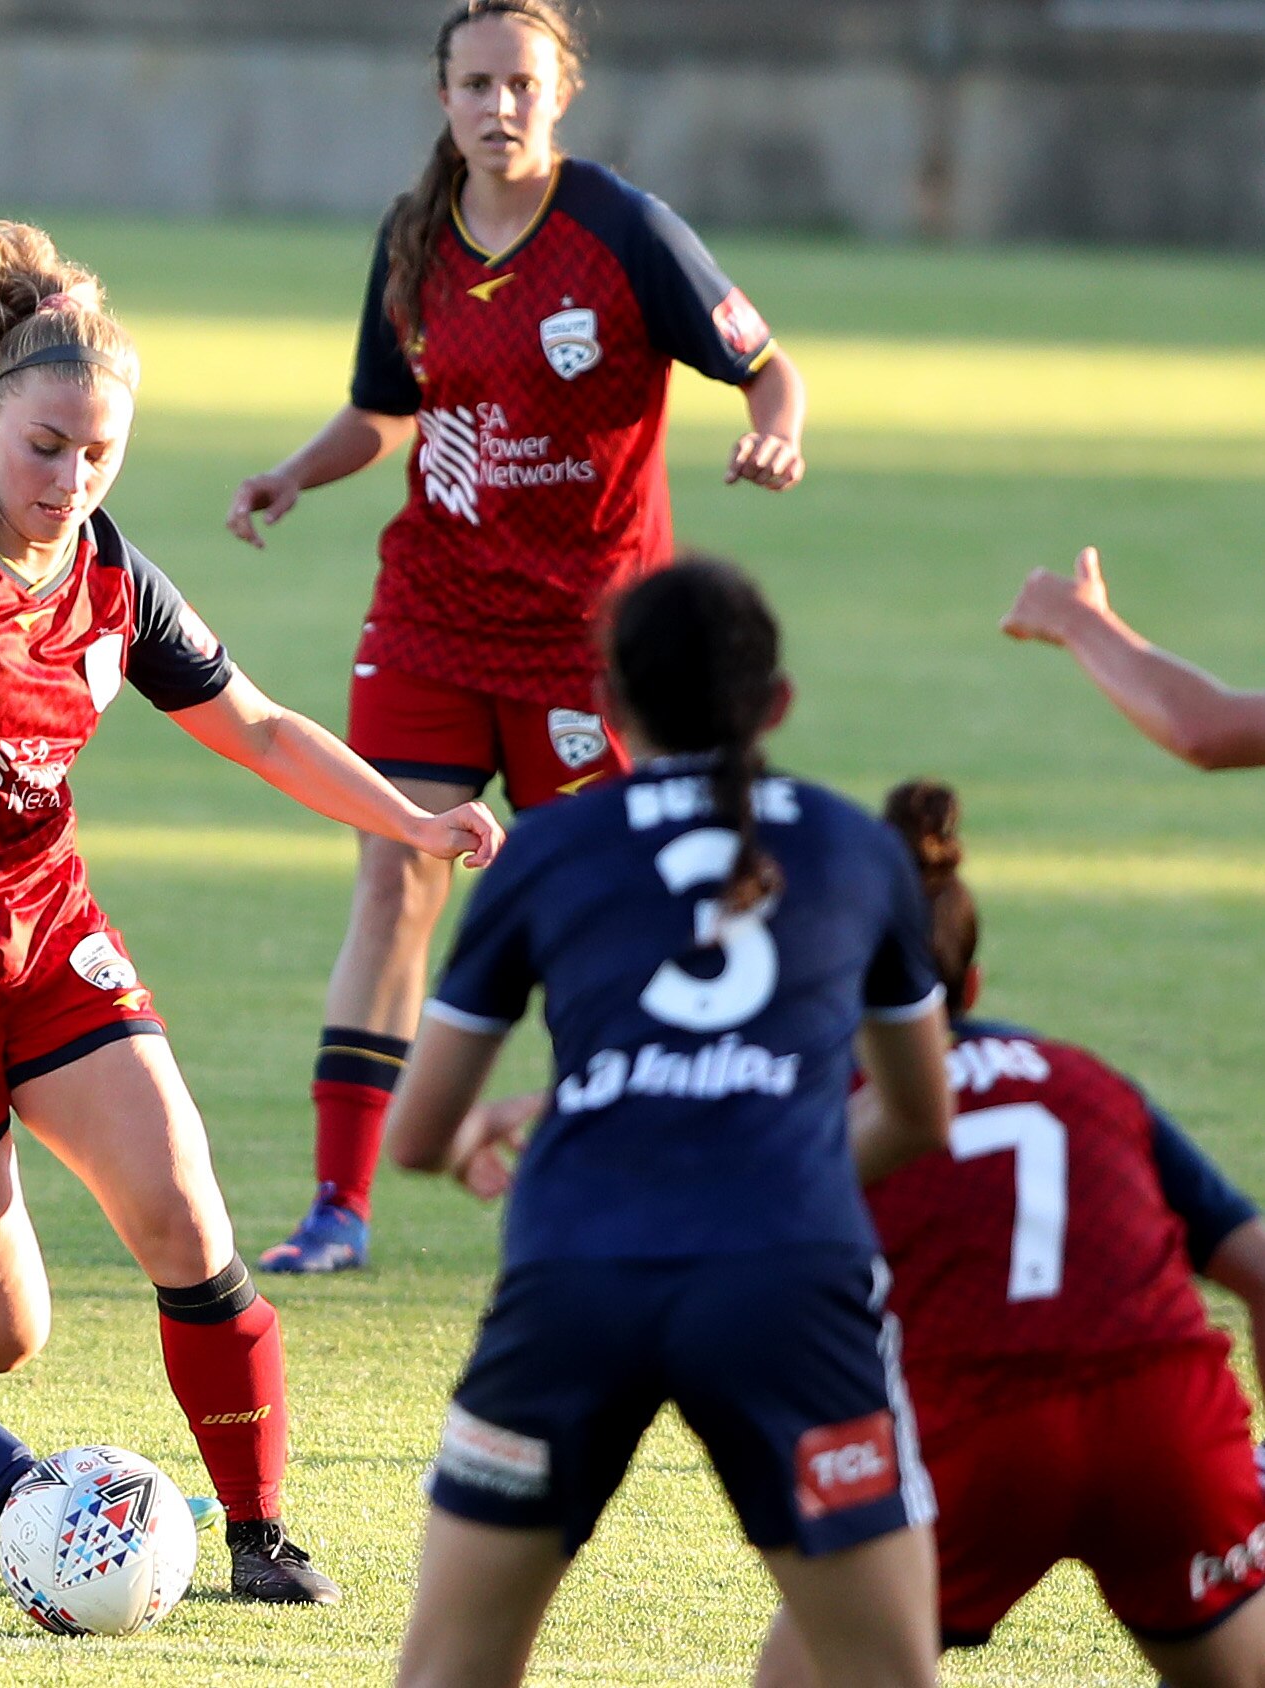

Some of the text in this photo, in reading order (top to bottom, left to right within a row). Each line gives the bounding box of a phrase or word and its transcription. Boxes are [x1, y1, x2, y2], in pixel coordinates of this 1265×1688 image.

[476, 402, 509, 431] SA
[479, 431, 552, 460] Power
[479, 455, 597, 488] Networks
[20, 739, 49, 764] SA
[638, 826, 780, 1034] 3
[947, 1100, 1070, 1304] 7
[809, 1440, 887, 1490] TCL
